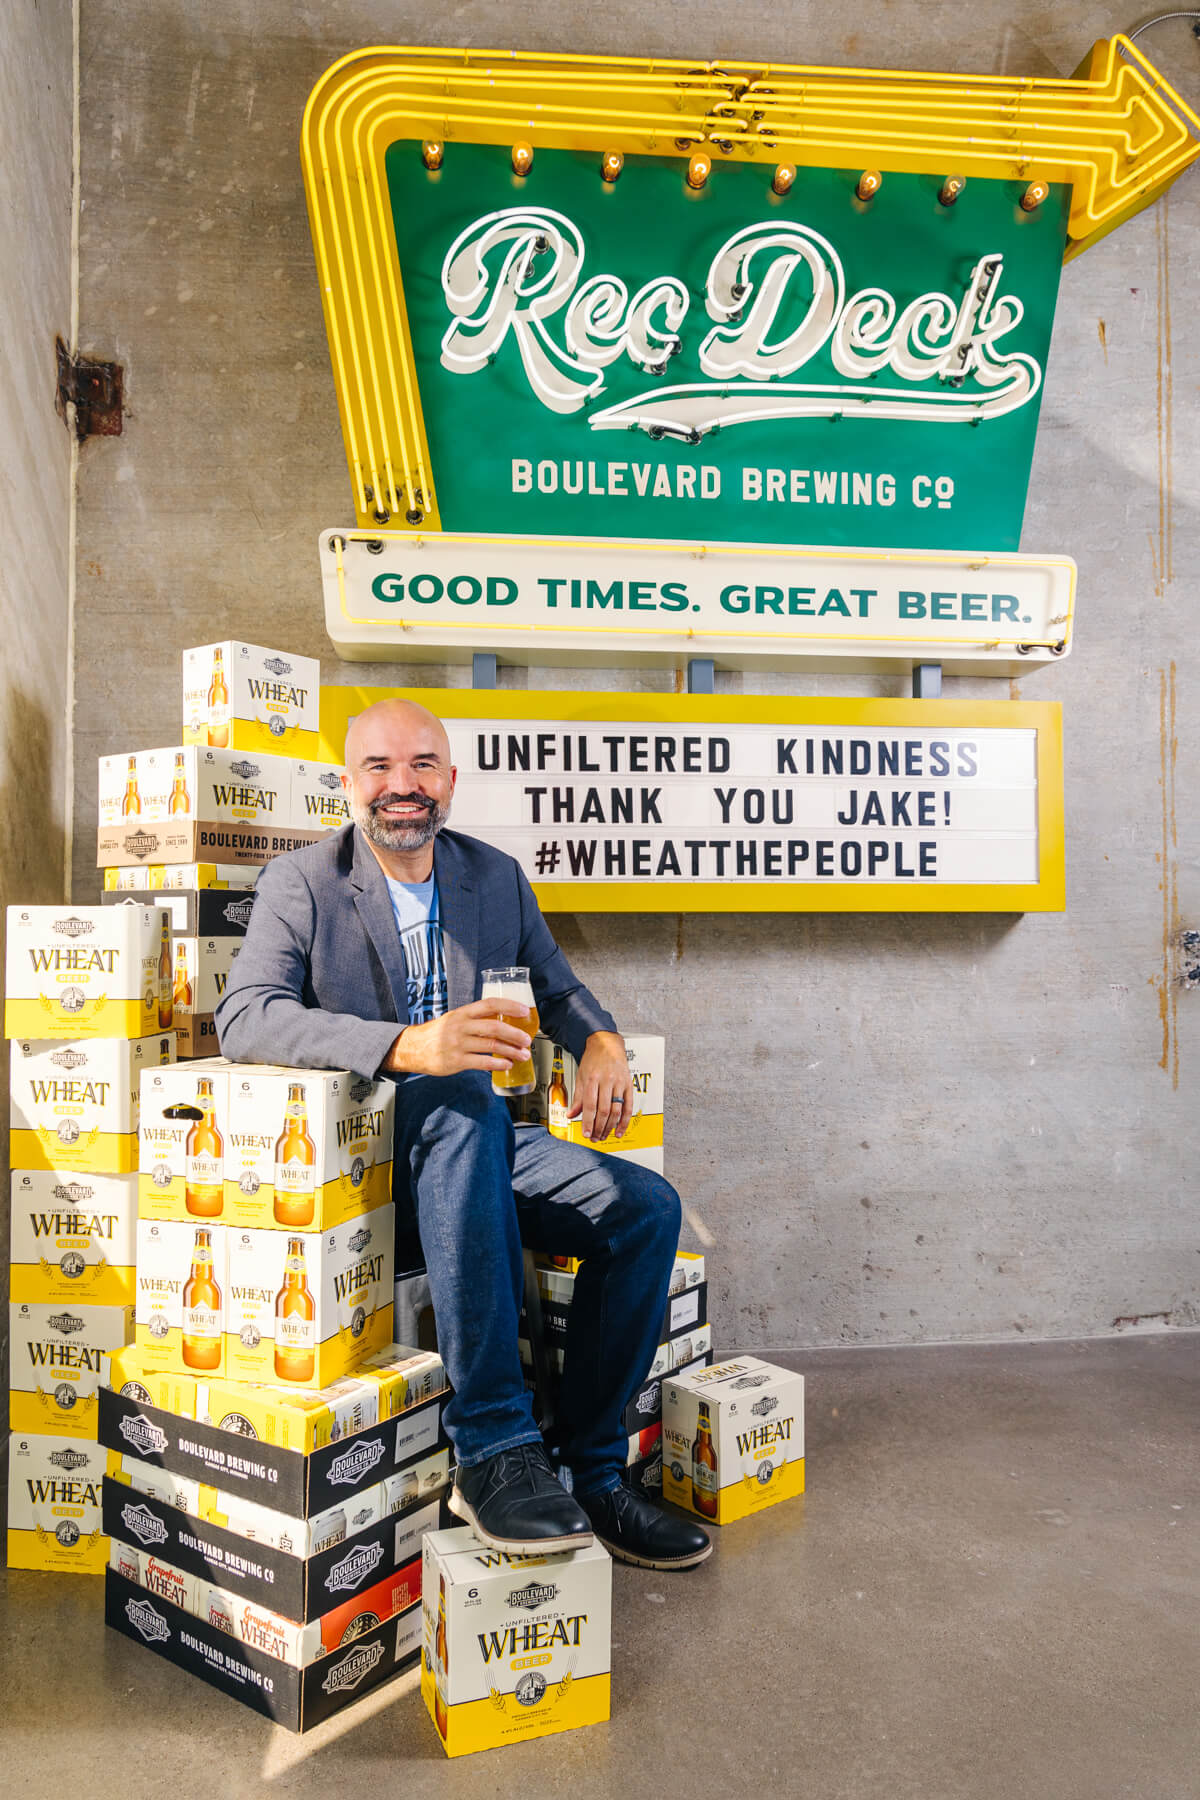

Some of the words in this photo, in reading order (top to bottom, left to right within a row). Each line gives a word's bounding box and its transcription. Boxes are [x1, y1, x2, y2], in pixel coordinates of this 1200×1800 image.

[440, 206, 690, 413] Rec
[698, 220, 1042, 392] Deck
[511, 458, 721, 499] BOULEVARD
[742, 466, 897, 508] BREWING
[371, 573, 520, 607] GOOD
[537, 578, 701, 614] TIMES.
[719, 584, 877, 618] GREAT
[898, 591, 1032, 624] BEER.
[247, 678, 309, 710] WHEAT
[206, 752, 214, 760] 6
[477, 734, 731, 774] UNFILTERED
[777, 737, 978, 778] KINDNESS
[212, 784, 278, 812] WHEAT
[304, 794, 352, 819] WHEA
[524, 786, 663, 825] THANK
[713, 787, 795, 826] YOU
[836, 789, 953, 827] JAKE!
[200, 831, 268, 850] BOULEVARD
[534, 839, 938, 878] #WHEATTHEPEOPLE
[20, 912, 30, 921] 6
[207, 941, 215, 949] 6
[28, 948, 120, 974] WHEAT
[22, 1043, 31, 1052] 6
[136, 1044, 143, 1053] 6
[30, 1080, 111, 1106] WHEAT
[153, 1076, 162, 1086] 6
[241, 1081, 250, 1091] 6
[332, 1080, 339, 1090] 6
[143, 1127, 185, 1143] WHEAT
[230, 1133, 274, 1150] WHEAT
[336, 1110, 385, 1148] WHEAT
[22, 1177, 31, 1185] 6
[30, 1213, 119, 1240] WHEAT
[150, 1226, 159, 1236] 6
[241, 1234, 250, 1244] 6
[329, 1236, 335, 1246] 6
[139, 1277, 182, 1294] WHEAT
[334, 1254, 385, 1305] WHEAT
[231, 1286, 274, 1304] WHEAT
[21, 1304, 29, 1313] 6
[27, 1342, 106, 1374] WHEAT
[730, 1403, 737, 1411] 6
[20, 1441, 28, 1450] 6
[126, 1421, 161, 1447] BOULEVARD
[664, 1428, 692, 1450] WHEAT
[735, 1416, 795, 1457] WHEAT
[51, 1452, 87, 1466] BOULEVARD
[178, 1438, 225, 1465] BOULEVARD
[226, 1454, 266, 1479] BREWING
[334, 1444, 379, 1479] BOULEVARD
[126, 1510, 163, 1538] BOULEVARD
[178, 1530, 223, 1561] BOULEVARD
[224, 1550, 262, 1579] BREWING
[314, 1530, 345, 1553] WHEAT
[147, 1556, 185, 1586] Grapefruit
[332, 1547, 377, 1586] BOULEVARD
[144, 1570, 188, 1609] WHEAT
[467, 1587, 479, 1599] 6
[511, 1585, 554, 1605] BOULEVARD
[131, 1605, 165, 1636] BOULEVARD
[242, 1605, 286, 1639] Grapefruit
[505, 1612, 560, 1628] UNFILTERED
[239, 1618, 289, 1661] WHEAT
[476, 1614, 588, 1665] WHEAT
[180, 1631, 224, 1665] BOULEVARD
[225, 1655, 262, 1686] BREWING
[330, 1646, 378, 1689] BOULEVARD
[515, 1654, 550, 1670] BEER
